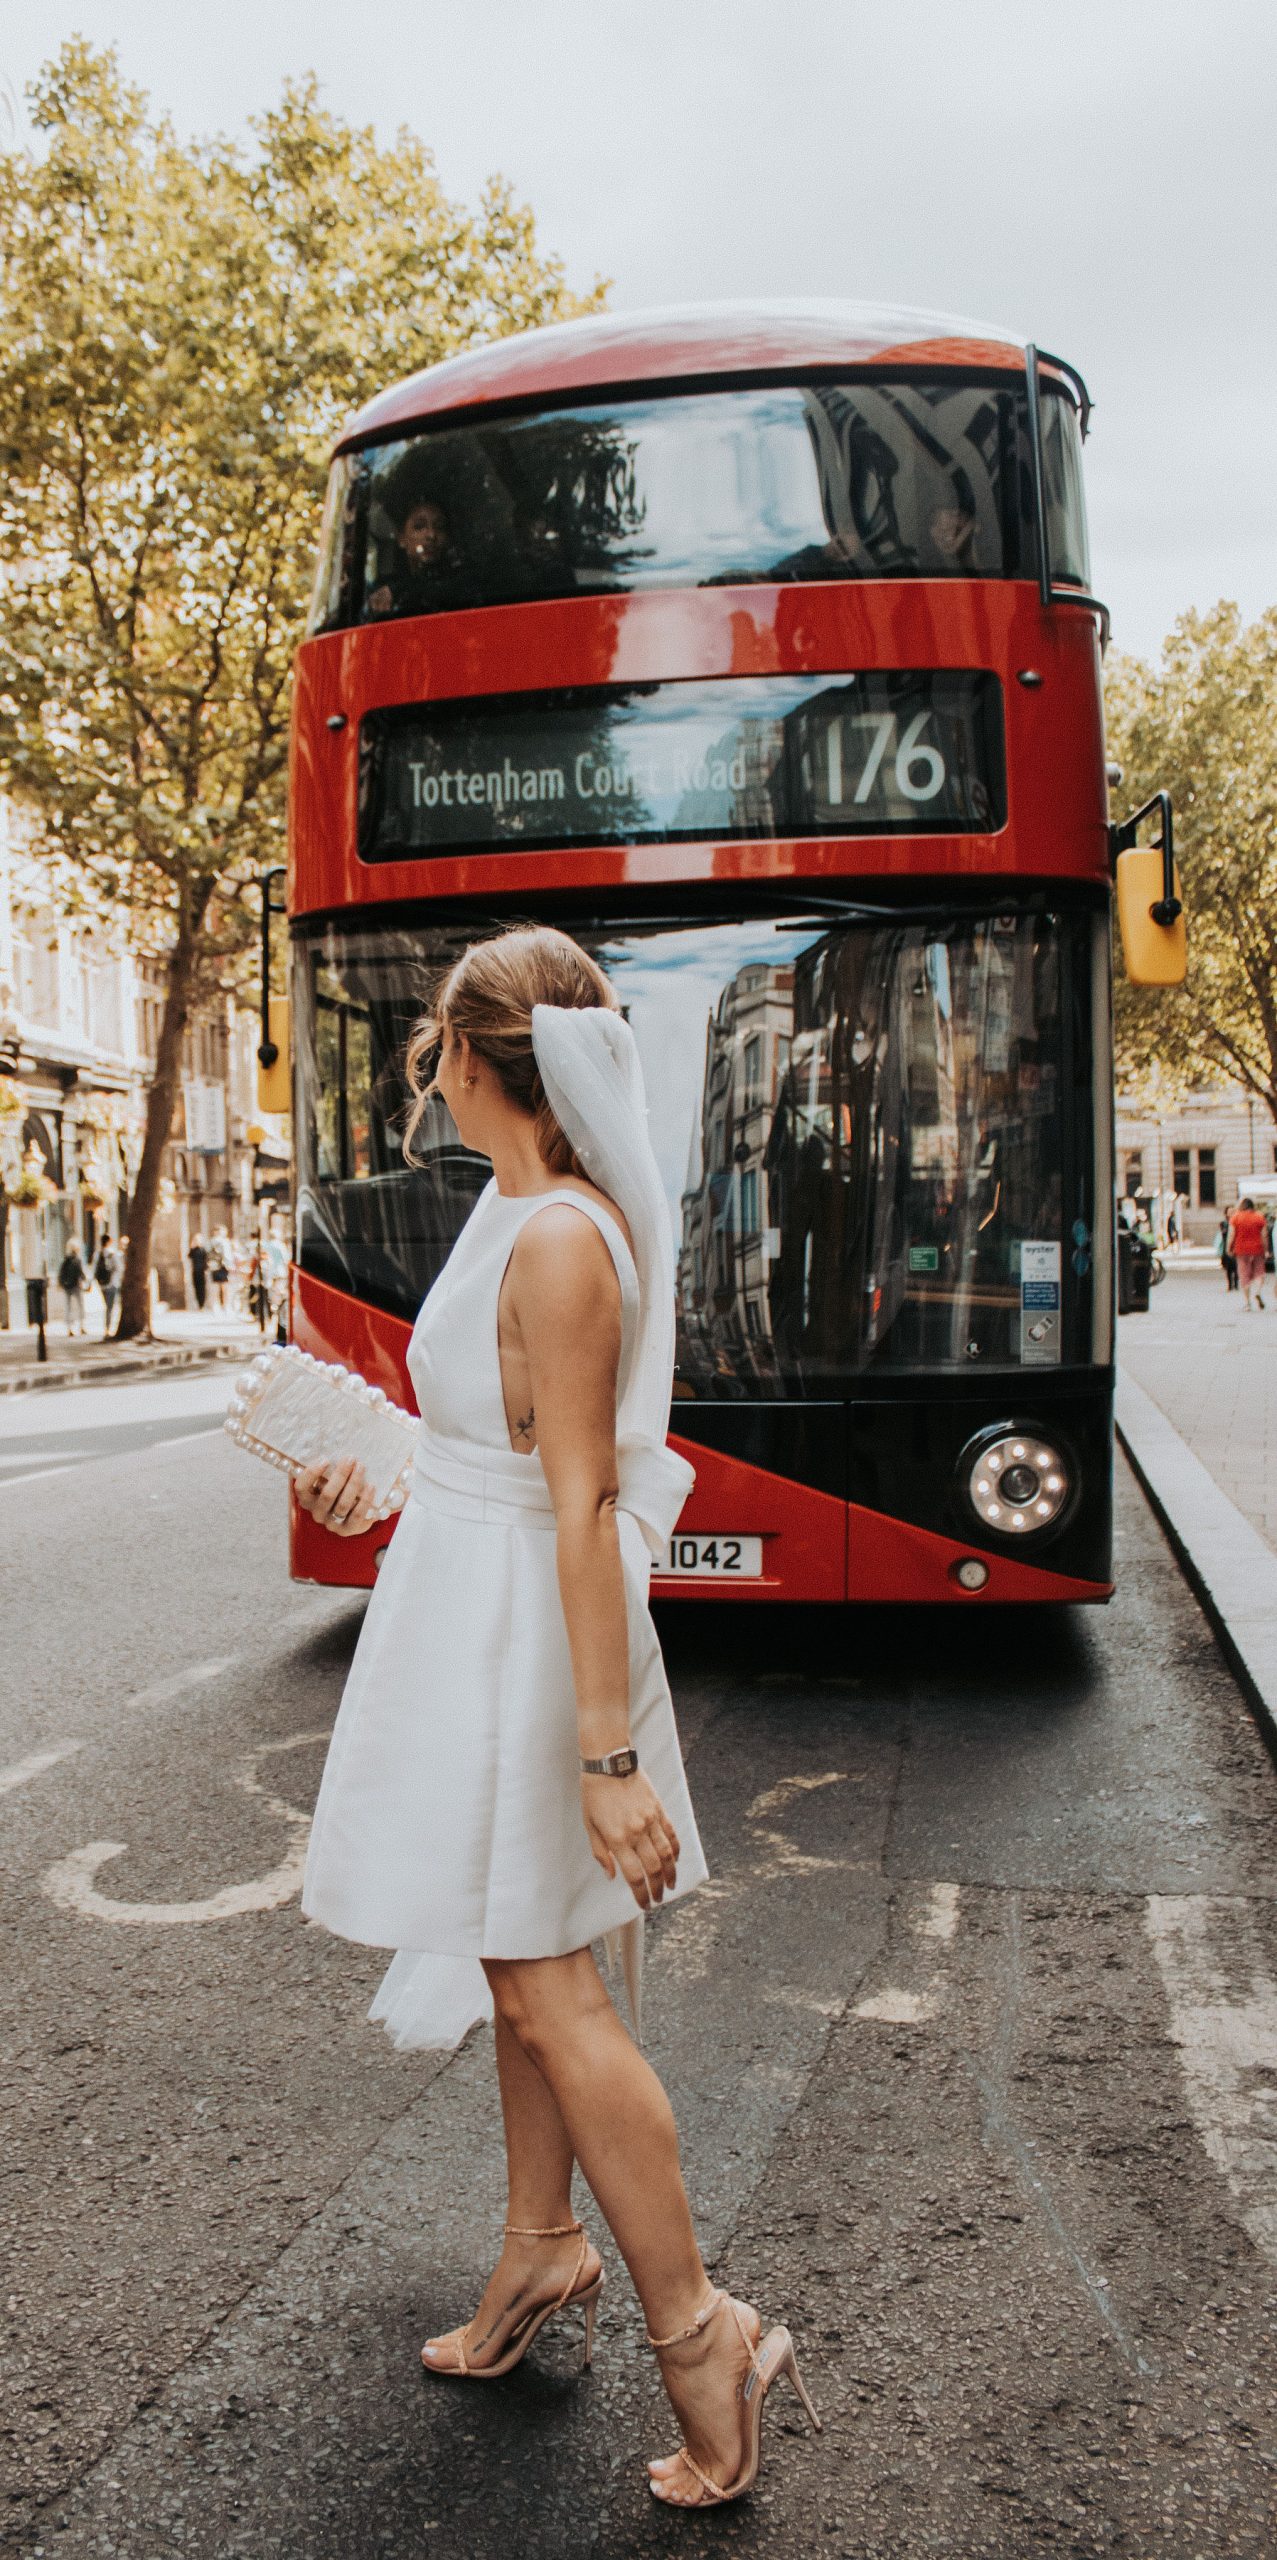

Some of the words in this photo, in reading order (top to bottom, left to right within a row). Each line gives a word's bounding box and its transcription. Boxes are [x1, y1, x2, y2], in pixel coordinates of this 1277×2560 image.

[408, 757, 565, 808] Tottenham
[827, 711, 946, 805] 176
[670, 1540, 741, 1569] 1042
